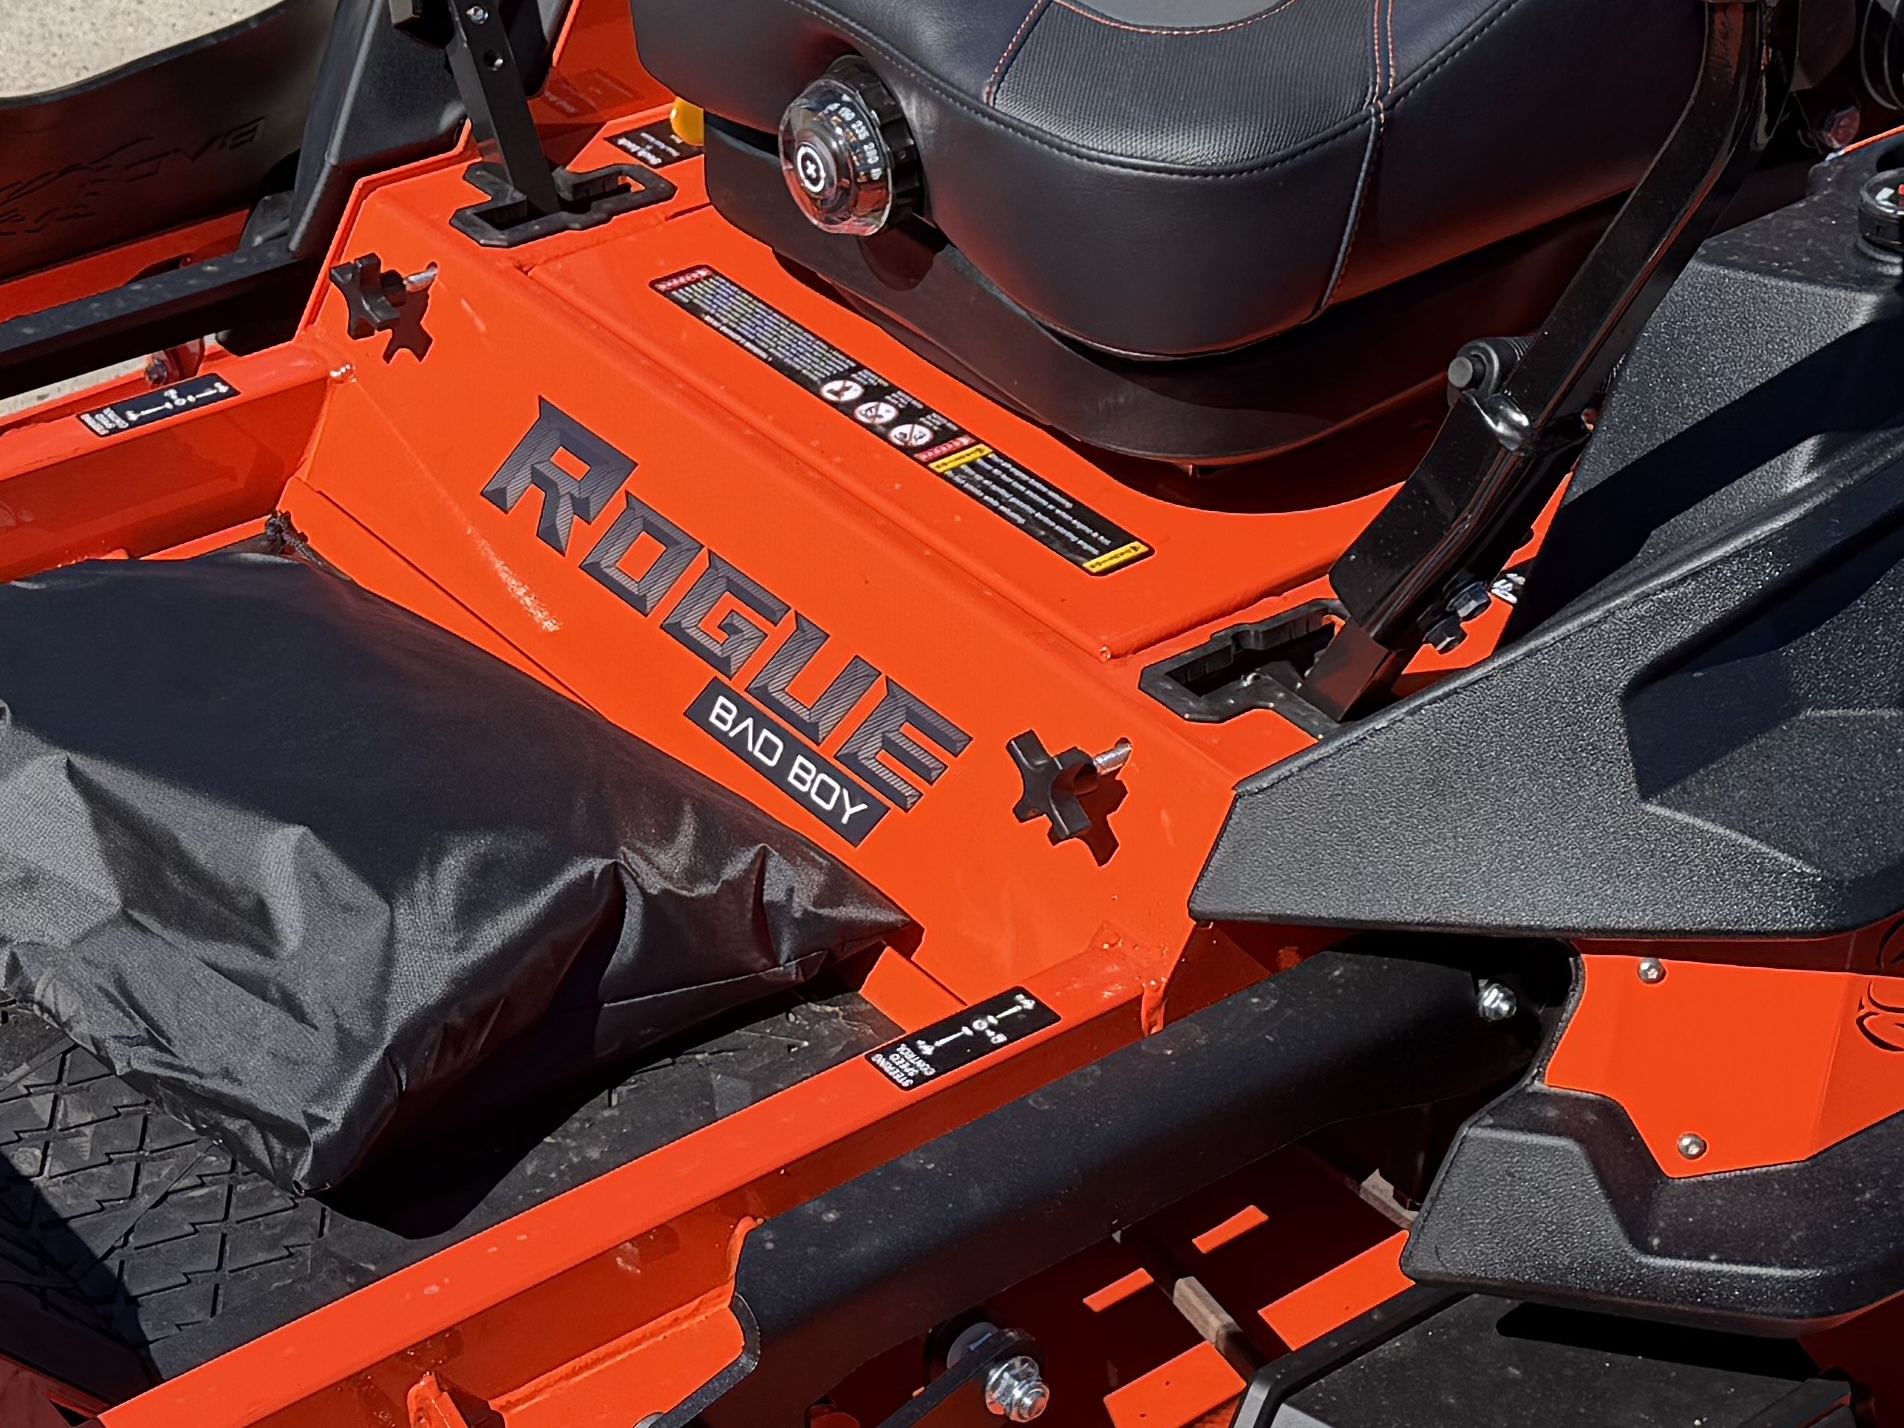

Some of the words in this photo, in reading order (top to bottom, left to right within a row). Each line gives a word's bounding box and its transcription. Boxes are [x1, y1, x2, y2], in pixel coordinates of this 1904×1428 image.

[480, 395, 975, 813] ROGUE
[707, 693, 784, 767] BAD
[786, 755, 869, 827] BOY
